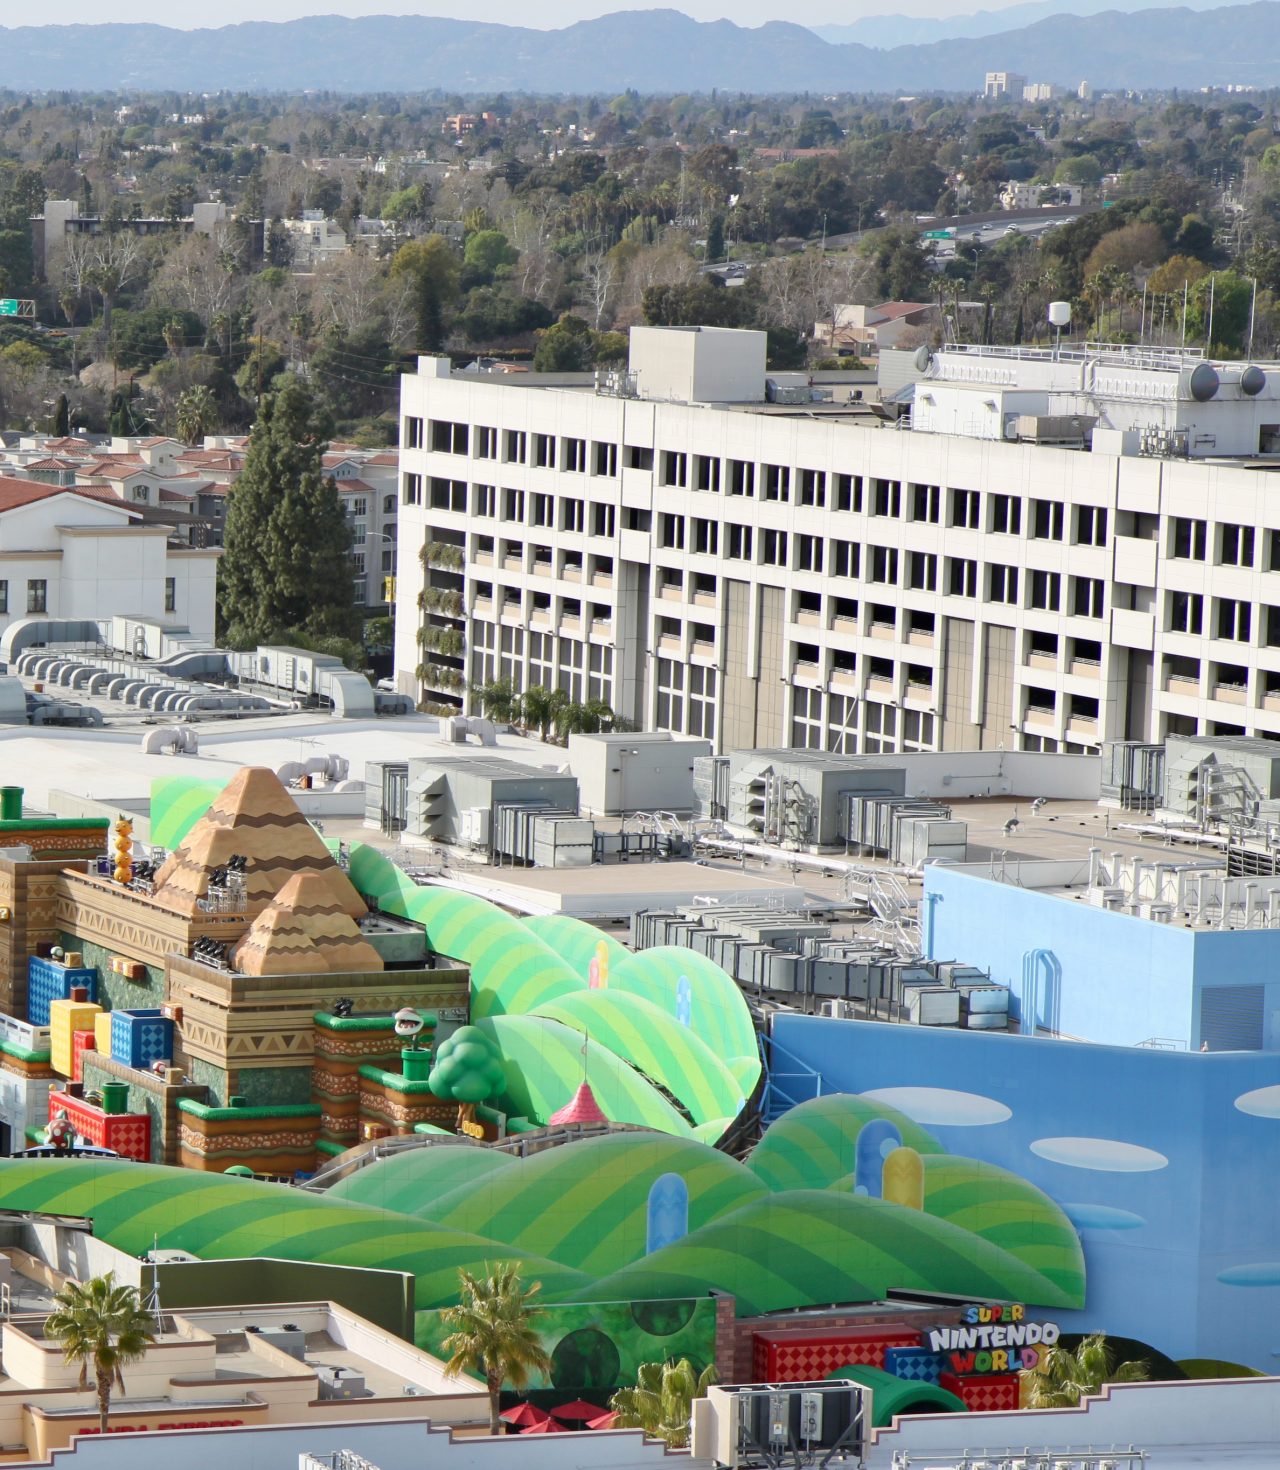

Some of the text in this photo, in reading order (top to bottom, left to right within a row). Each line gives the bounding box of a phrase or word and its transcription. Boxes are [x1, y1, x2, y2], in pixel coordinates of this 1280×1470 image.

[966, 1305, 1024, 1323] SUPER
[930, 1323, 1060, 1352] NINTENDO
[951, 1349, 1039, 1373] WORLD
